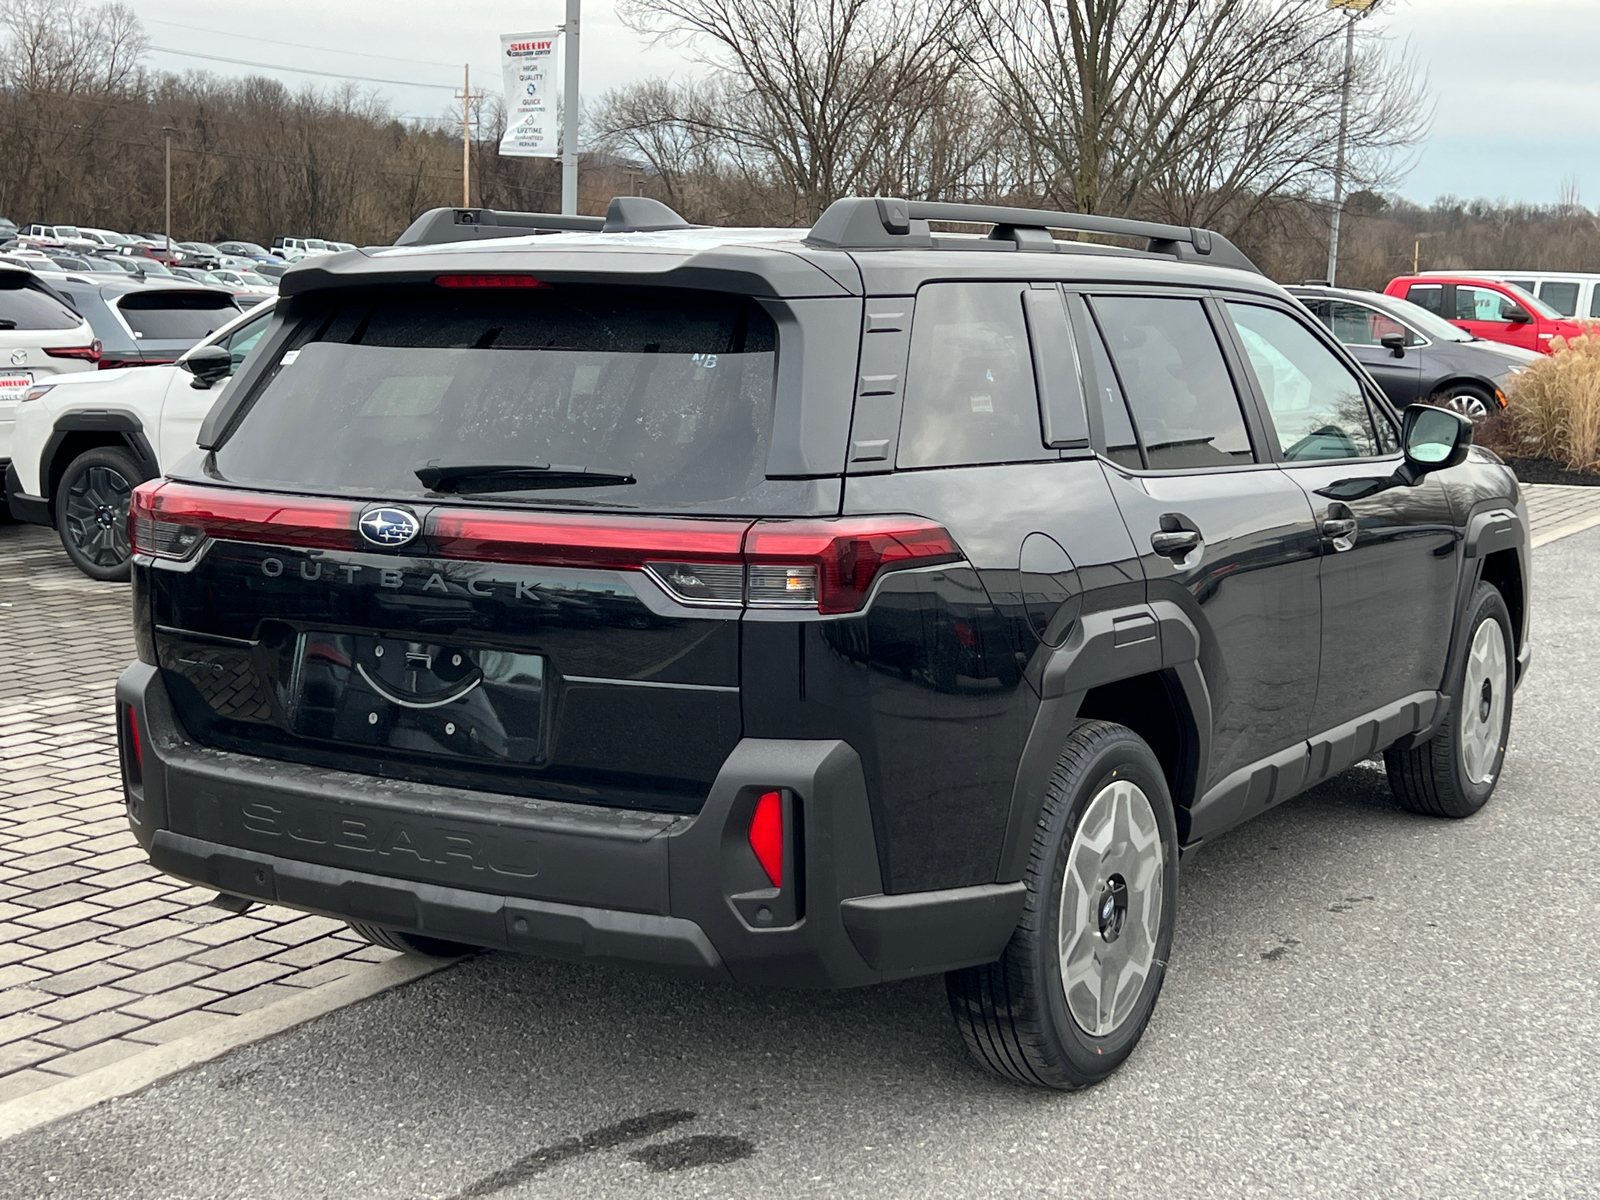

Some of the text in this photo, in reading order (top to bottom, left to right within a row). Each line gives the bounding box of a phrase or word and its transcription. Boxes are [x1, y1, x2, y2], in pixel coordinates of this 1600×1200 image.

[510, 41, 552, 51] SHEEHY
[522, 98, 541, 106] QUICK
[261, 557, 541, 601] OUTBACK
[242, 802, 539, 878] SUBARU
